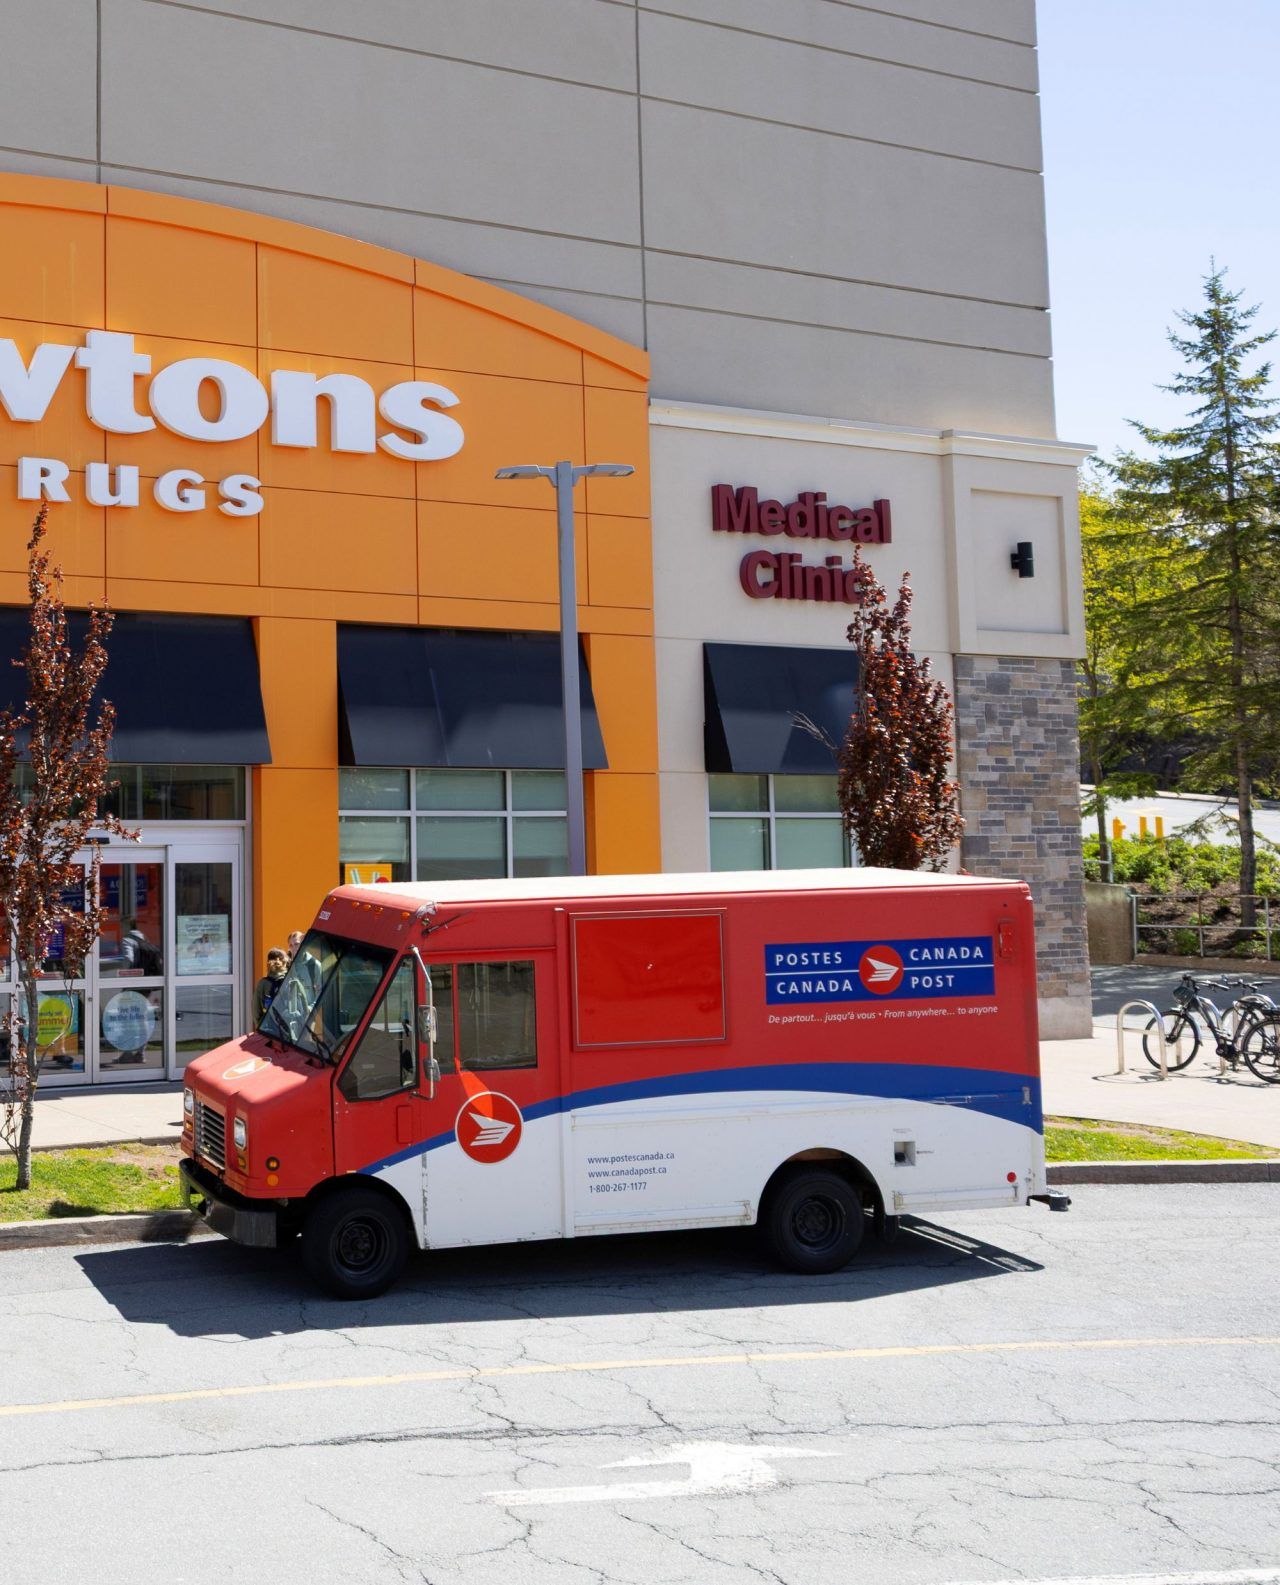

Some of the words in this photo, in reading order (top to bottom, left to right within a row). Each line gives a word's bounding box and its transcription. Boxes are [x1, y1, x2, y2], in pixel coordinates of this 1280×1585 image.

[711, 483, 892, 544] Medical
[739, 550, 866, 604] Clinic
[775, 952, 843, 966] POSTES
[909, 946, 984, 961] CANADA
[776, 979, 853, 995] CANADA
[911, 975, 956, 989] POST
[37, 1016, 69, 1025] ummer
[768, 1014, 781, 1023] De
[782, 1013, 823, 1024] partout...
[824, 1011, 855, 1024] jusqu'à
[856, 1012, 876, 1020] vous
[884, 1009, 906, 1019] From
[907, 1007, 955, 1018] anywhere...
[958, 1006, 967, 1015] to
[968, 1005, 998, 1016] anyone
[587, 1152, 675, 1164] www.postescanada.ca
[588, 1166, 667, 1178] www.canadapost.ca
